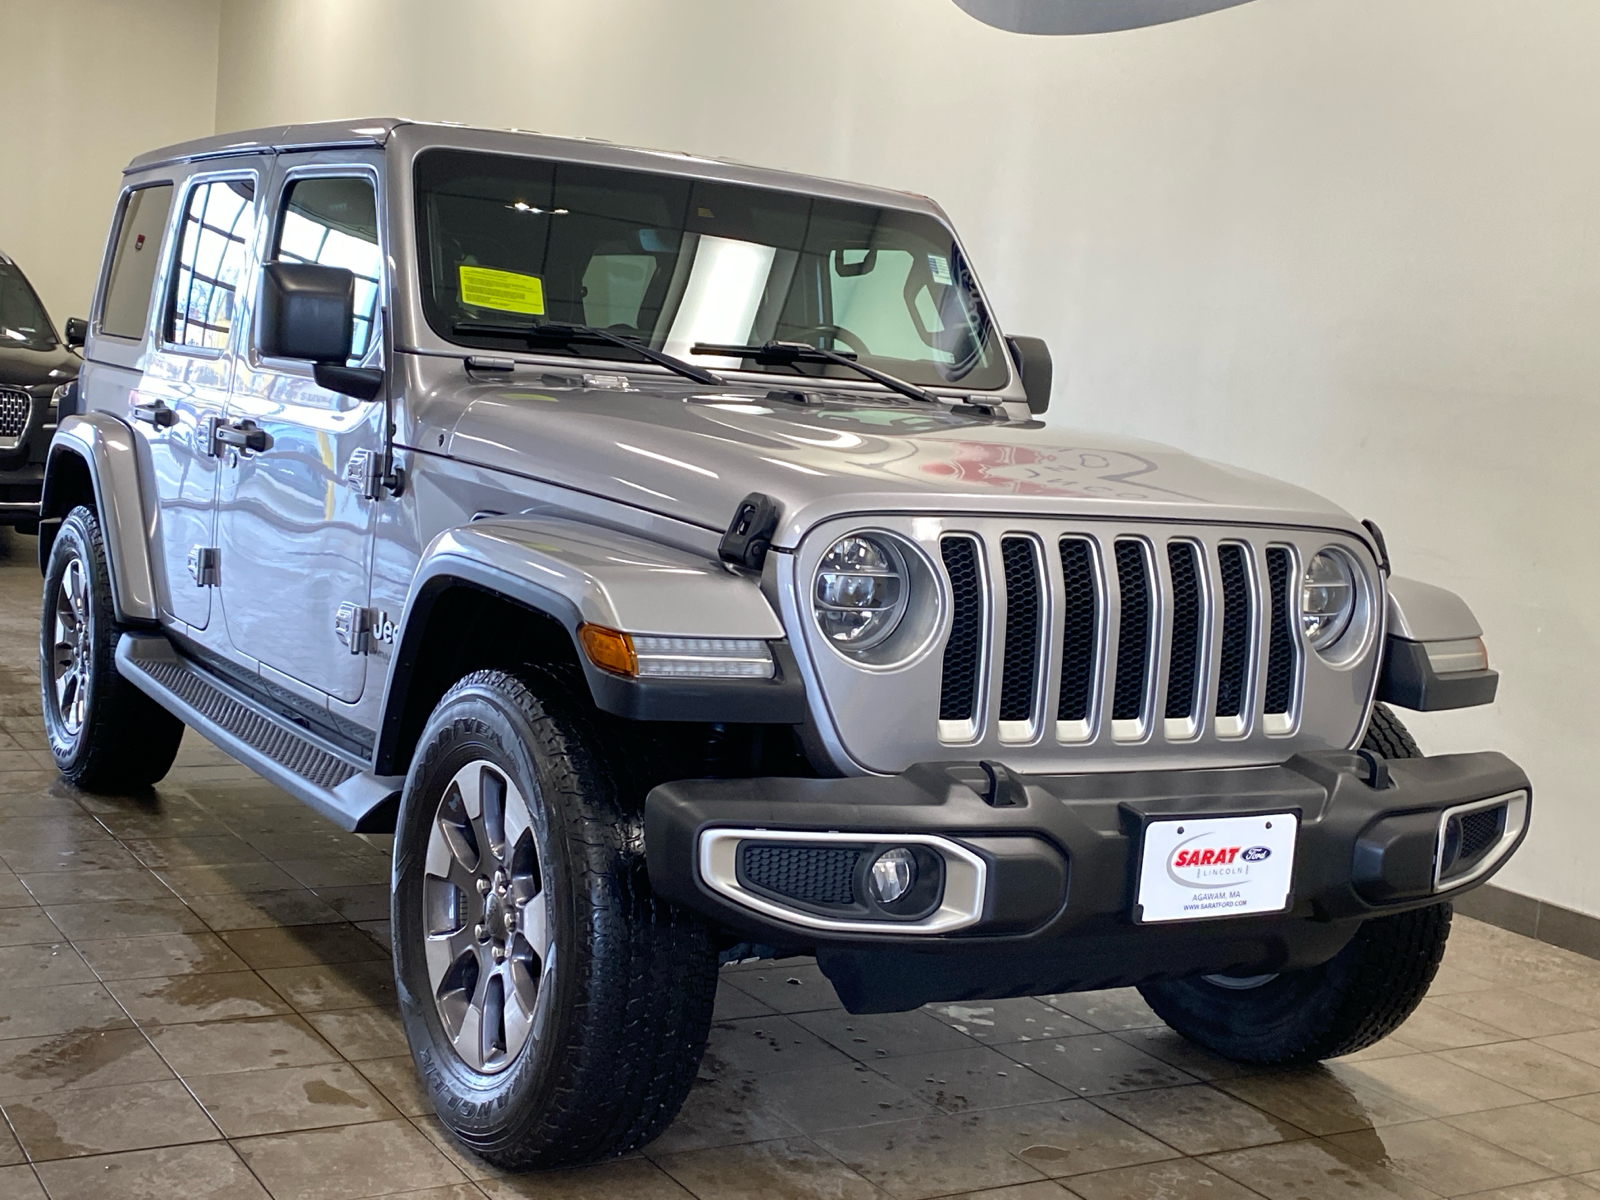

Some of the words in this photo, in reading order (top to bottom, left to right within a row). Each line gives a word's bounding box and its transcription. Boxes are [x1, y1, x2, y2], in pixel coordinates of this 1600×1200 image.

[373, 611, 399, 645] Jee
[405, 717, 521, 820] GOODYEAR
[1175, 847, 1241, 867] SARAT
[1244, 847, 1268, 861] Ford
[1203, 868, 1242, 876] LINCOLN
[1192, 892, 1227, 901] AGAWAM,
[1229, 891, 1241, 899] MA
[1184, 900, 1247, 910] WWW.SARATFORD.COM
